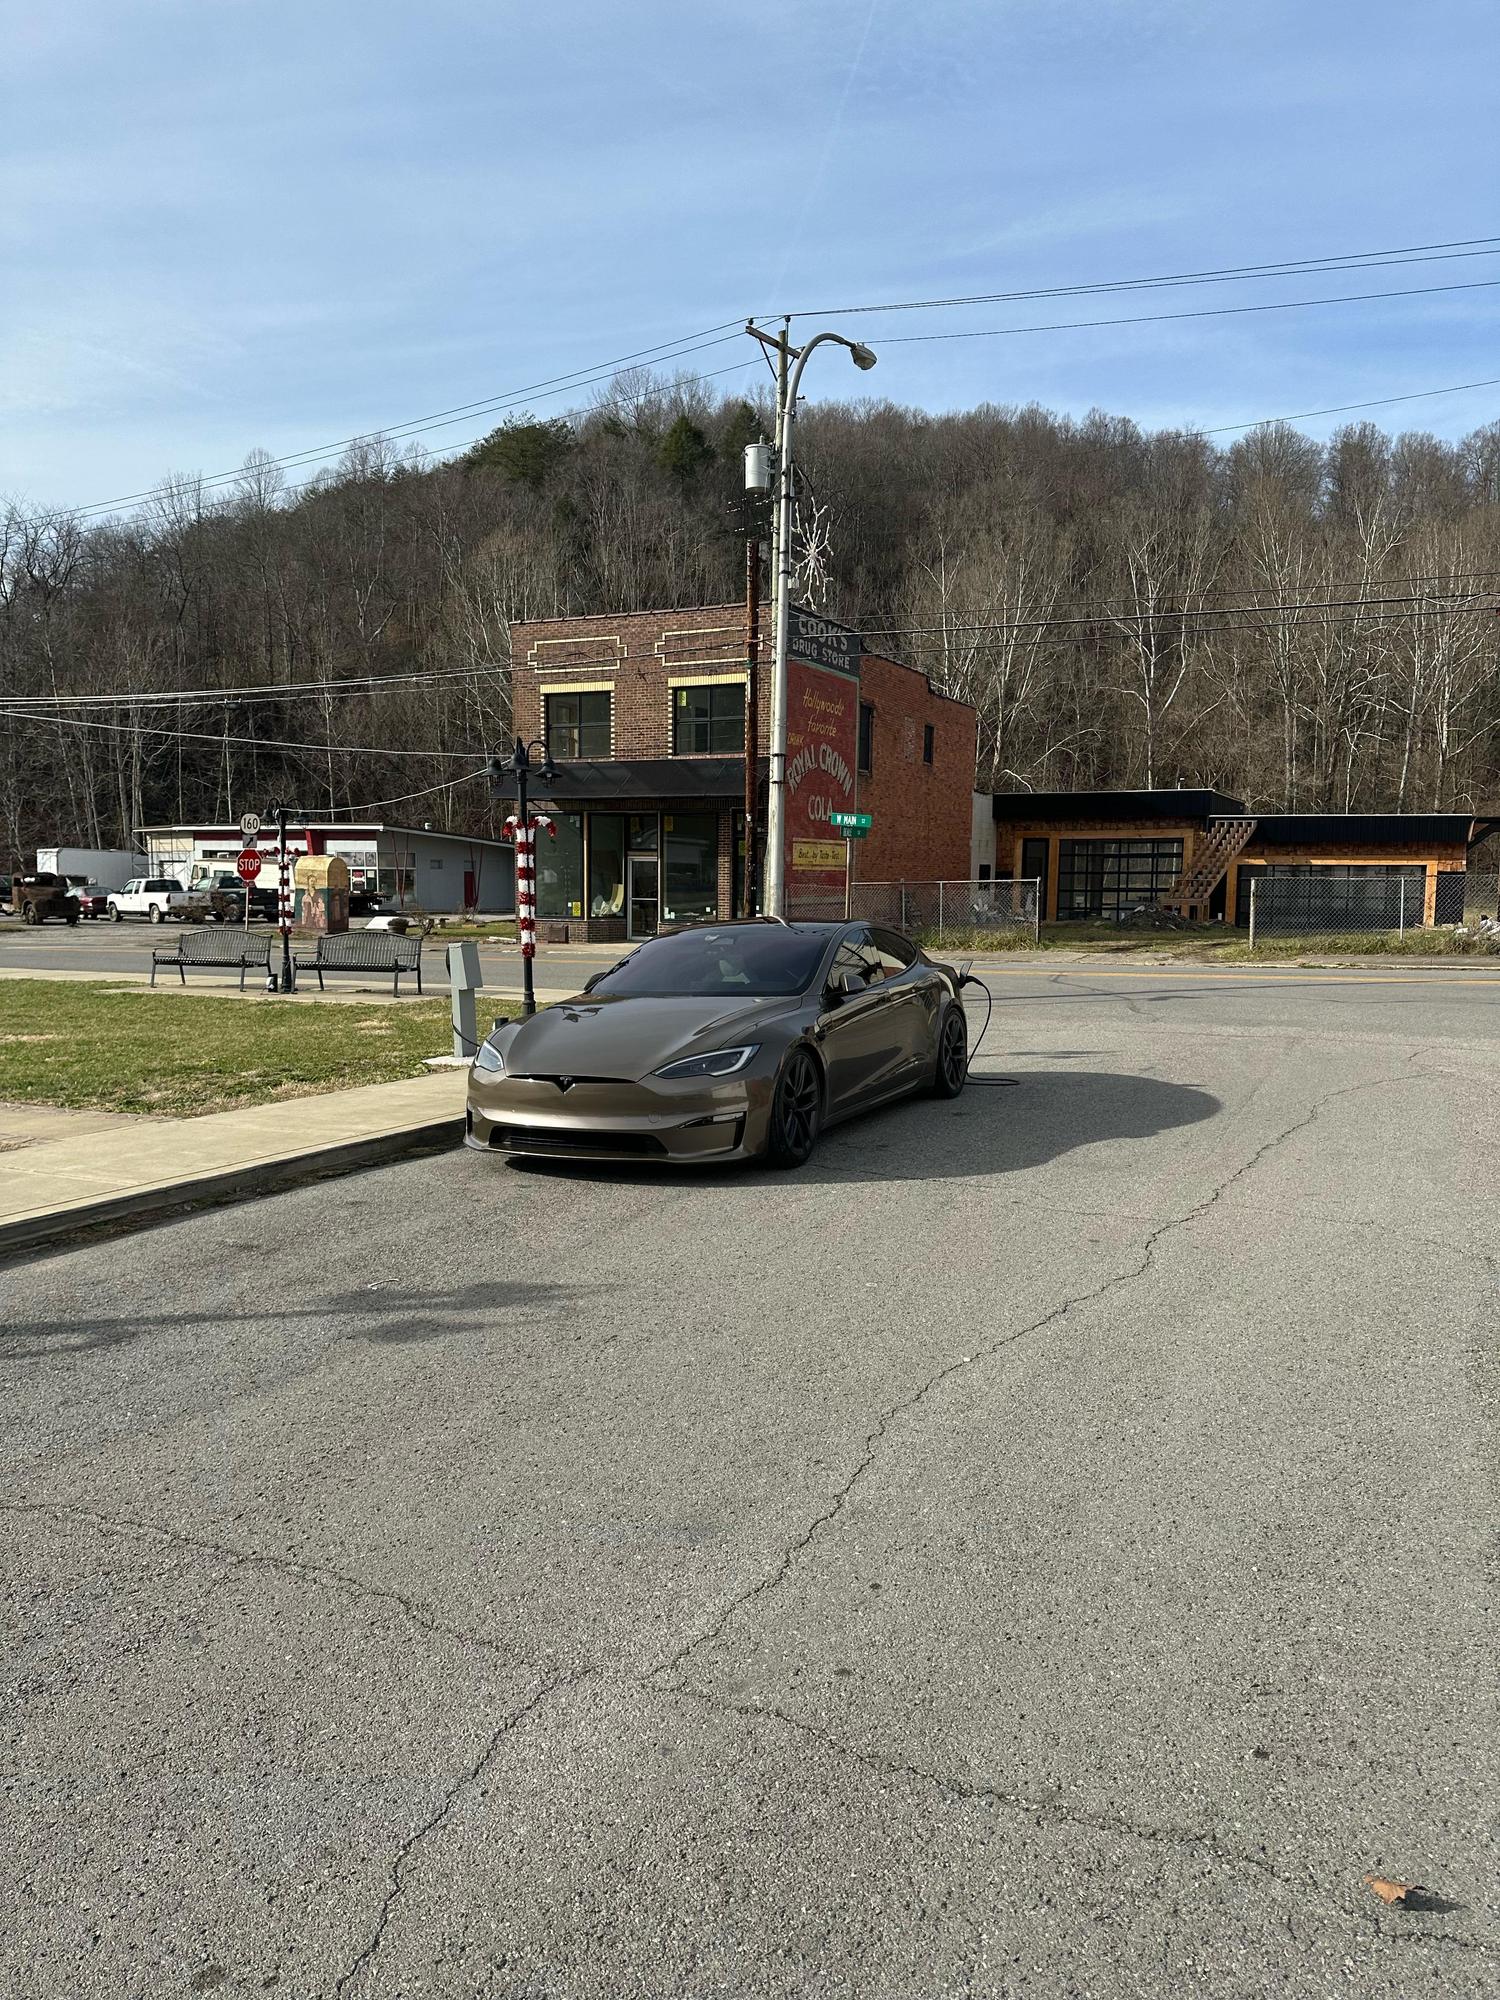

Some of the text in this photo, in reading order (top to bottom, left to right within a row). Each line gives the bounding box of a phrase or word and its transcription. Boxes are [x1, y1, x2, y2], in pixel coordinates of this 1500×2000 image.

[798, 616, 848, 651] COOK'S
[793, 638, 850, 669] DRUG STORE
[808, 715, 837, 737] favorite
[786, 742, 853, 797] ROYAL CROWN
[808, 795, 832, 822] COLA
[836, 815, 842, 824] W
[843, 815, 857, 824] MAIN
[243, 818, 258, 829] 160
[239, 858, 260, 871] STOP
